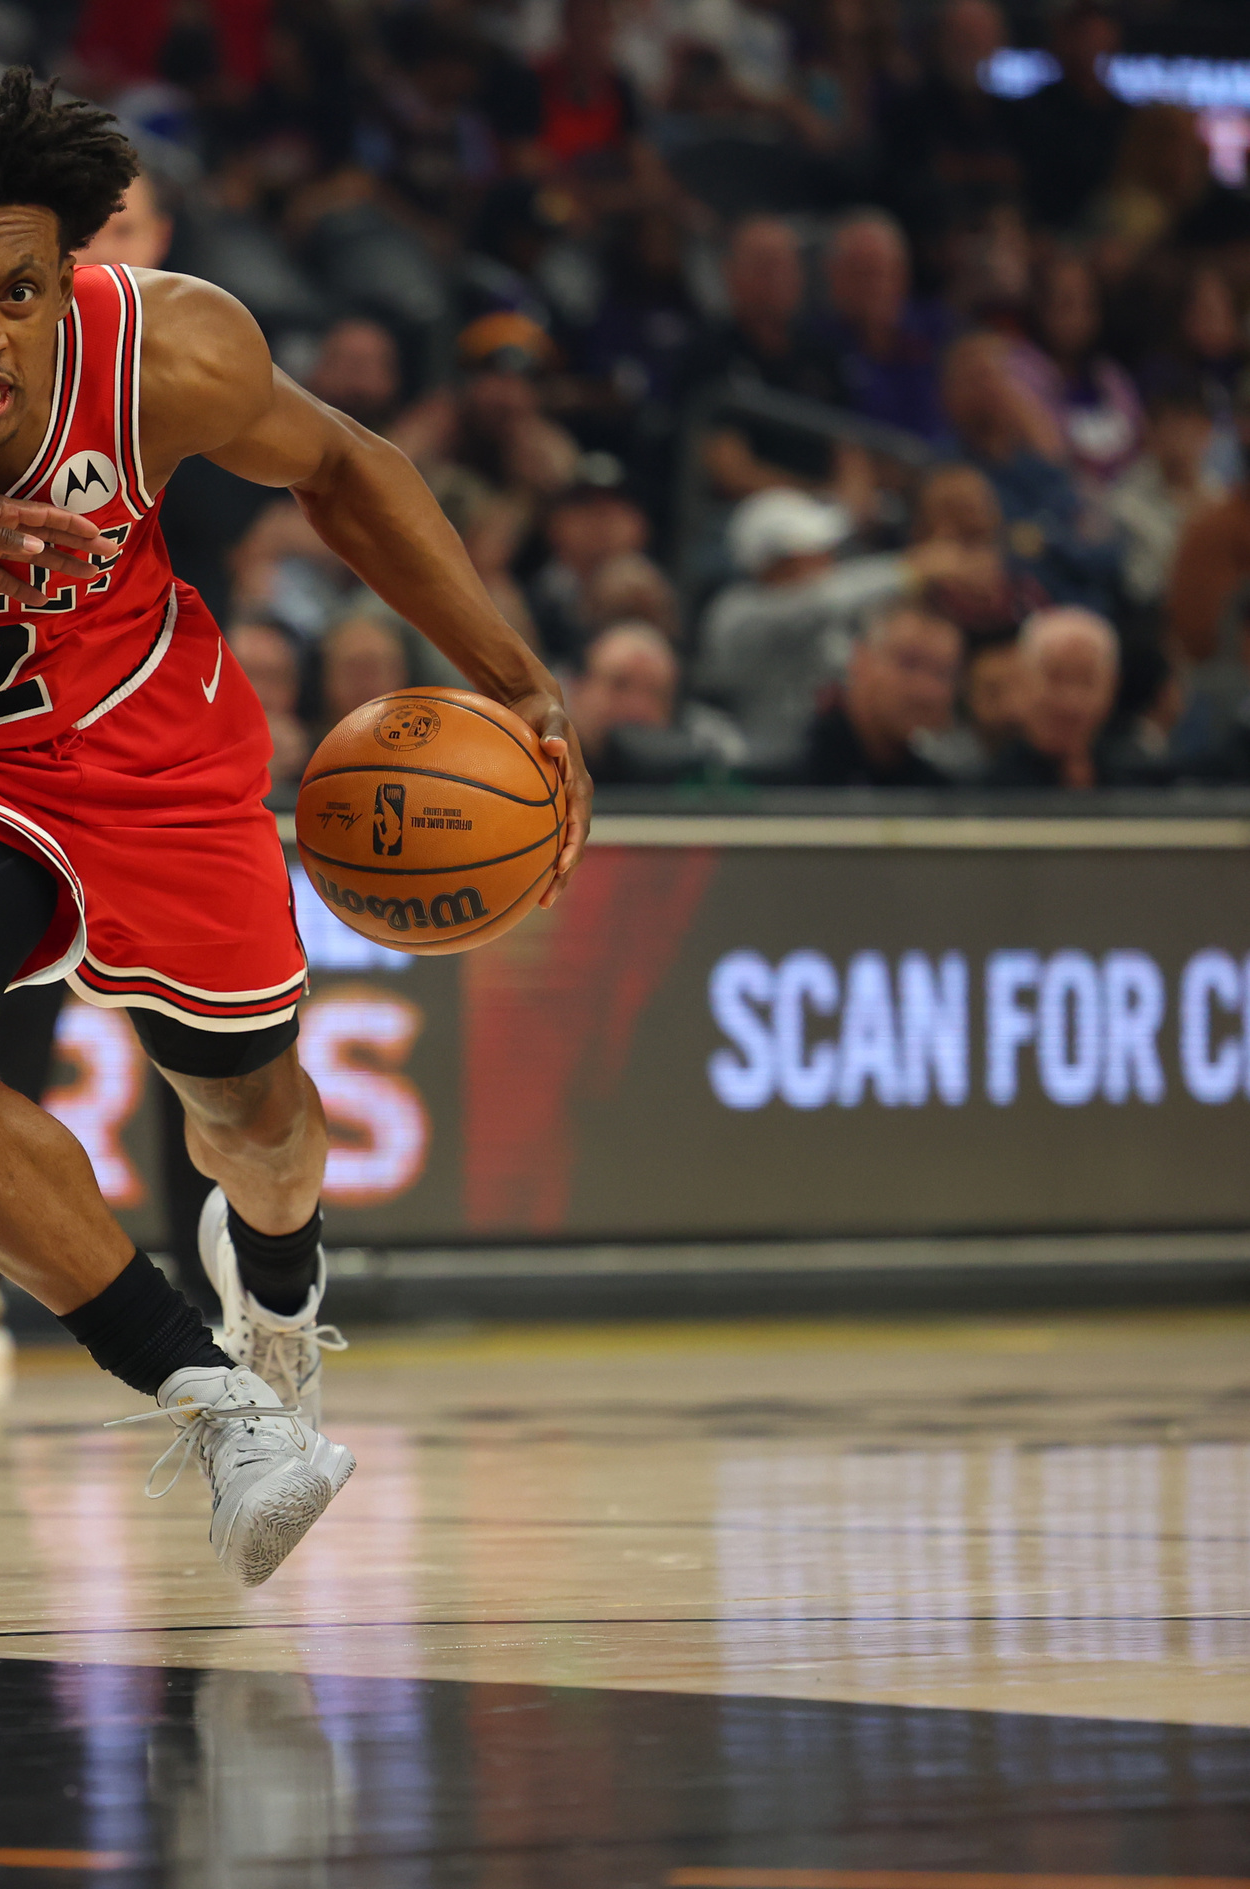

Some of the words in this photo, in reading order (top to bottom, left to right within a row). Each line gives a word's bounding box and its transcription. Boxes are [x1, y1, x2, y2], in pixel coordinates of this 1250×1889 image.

[410, 816, 426, 828] BALL
[427, 817, 444, 829] GAME
[446, 818, 472, 831] OFFICIAL
[316, 871, 490, 931] Wilson
[707, 946, 971, 1110] SCAN
[984, 946, 1167, 1107] FOR
